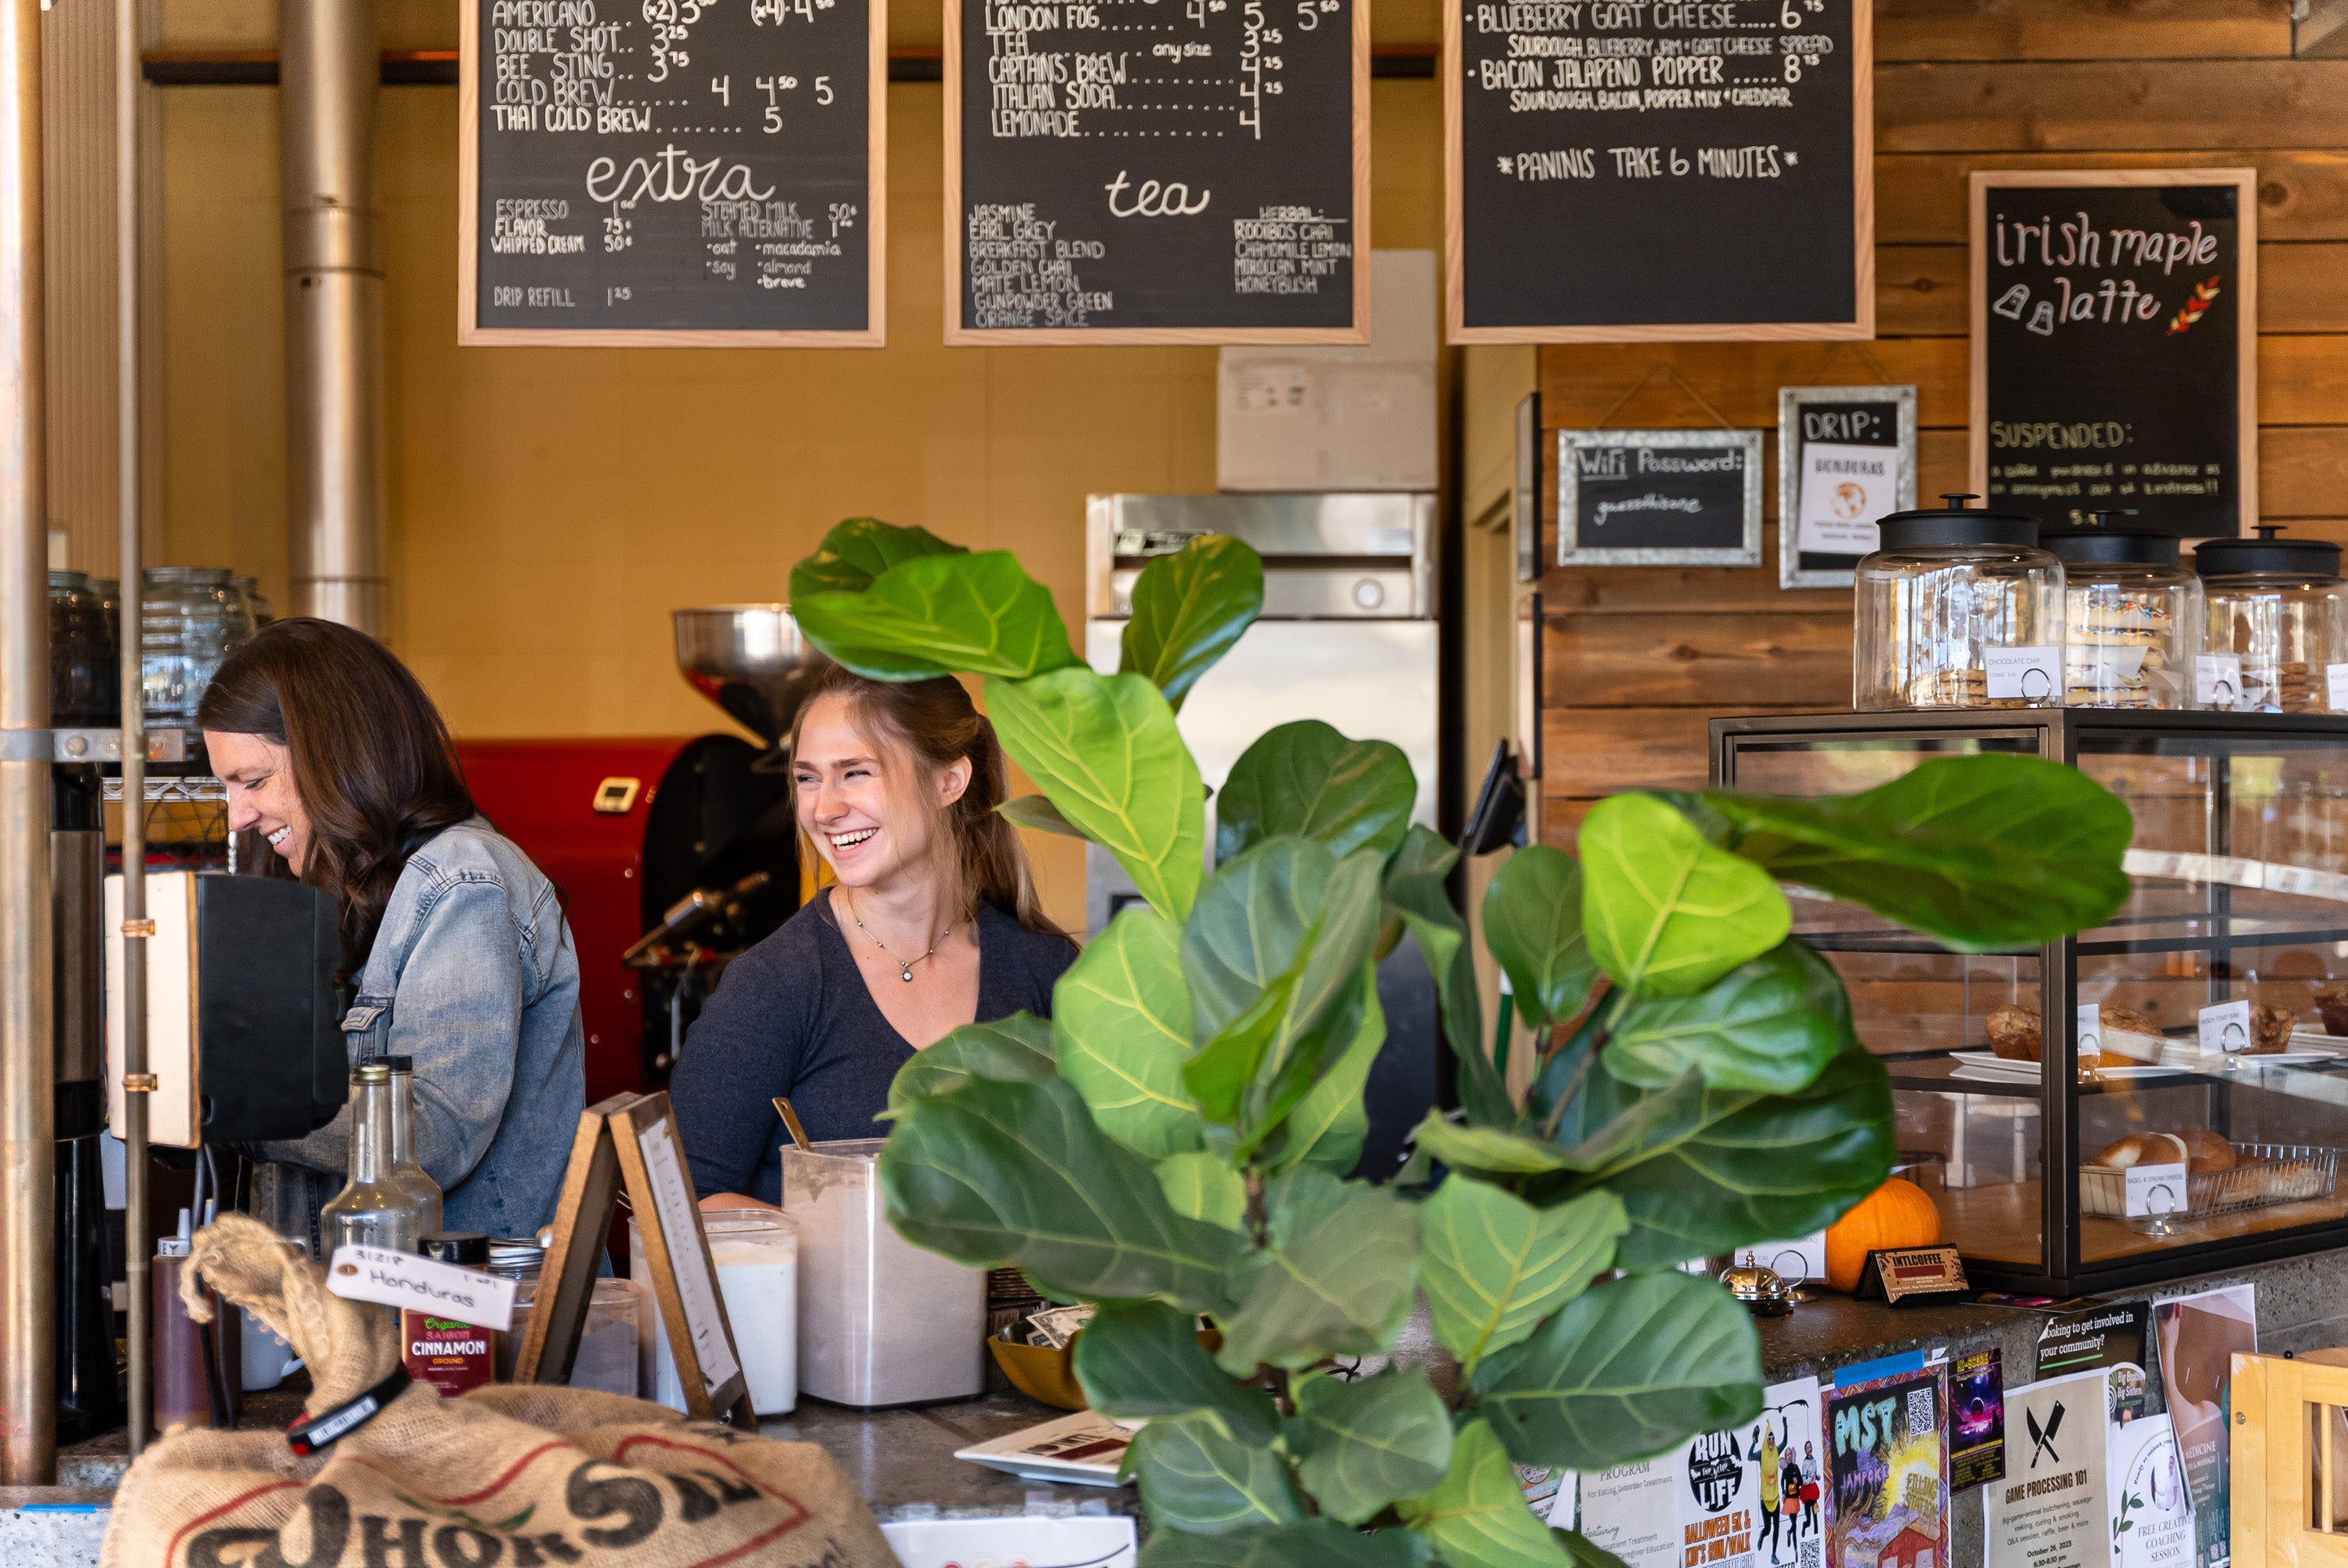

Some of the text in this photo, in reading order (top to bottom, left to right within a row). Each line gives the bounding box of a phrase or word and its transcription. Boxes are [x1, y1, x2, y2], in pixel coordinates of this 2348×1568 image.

[492, 0, 596, 27] AMERICANO
[985, 1, 1265, 31] LONDON FOG 5
[1477, 3, 1738, 34] BLUEBERRY GOAT CHEESE
[495, 28, 559, 53] DOUBLE
[985, 31, 1212, 64] TEA any size
[1692, 38, 1723, 55] GOAT
[1724, 37, 1773, 56] CHEESE
[1779, 34, 1834, 55] SPREAD
[496, 53, 532, 79] BEE
[1076, 54, 1127, 85] BREW
[1481, 55, 1724, 89] BACON JALAPENO POPPER
[496, 74, 834, 107] COLD BREW 4 5
[993, 80, 1116, 110] ITALIAN SODA
[1645, 87, 1793, 109] POPPER MIX CHEDDAR
[490, 104, 783, 134] THAI COLD BREW 5
[991, 109, 1261, 140] LEMONADE 4
[587, 143, 776, 202] extra
[1608, 144, 1781, 179] TAKE 6 MINUTES
[1104, 170, 1211, 217] tea
[496, 198, 569, 220] ESPRESSO
[701, 201, 801, 221] STEAMED MILK
[969, 202, 1036, 223] JASMINE
[495, 218, 548, 238] FLAVOR
[701, 219, 814, 239] MILK ALTERNATIVE
[969, 220, 1057, 241] EARL GREY
[1234, 221, 1333, 241] ROOIBOS CHAI
[491, 235, 586, 255] WHIPPED CREAM
[712, 238, 842, 256] oat macadamia
[969, 240, 1106, 259] BREAKFAST BLEND
[1235, 240, 1351, 259] CHAMOMILE LEMON
[1996, 212, 2218, 276] irish maple
[712, 258, 812, 281] soy almond
[971, 258, 1072, 275] GOLDEN CHAI
[1301, 259, 1338, 274] MINT
[763, 274, 806, 289] breve
[972, 274, 1080, 293] MATE LEMON
[1235, 275, 1318, 294] HONEYBUSH
[494, 285, 576, 307] DRIP REFILL
[974, 291, 1113, 311] GUNPOWDER GREEN
[2053, 277, 2161, 324] latte
[976, 309, 1089, 328] ORANGE SPICE
[1804, 411, 1881, 440] DRIP:
[1990, 420, 2134, 449] SUSPENDED:
[369, 1269, 474, 1308] Honduras
[2072, 1312, 2133, 1334] to get involved in
[426, 1331, 470, 1341] SAIGON
[412, 1341, 487, 1356] CINNAMON
[2041, 1334, 2105, 1361] your community?
[1835, 1396, 1896, 1457] MST
[1696, 1431, 1732, 1461] RUN
[1600, 1461, 1650, 1482] PROGRAM
[1598, 1487, 1617, 1497] Eating
[1618, 1482, 1642, 1493] Disorder
[1644, 1476, 1673, 1487] Treatment
[1699, 1477, 1736, 1510] LIFE
[2005, 1468, 2087, 1504] GAME PROCESSING 101
[1584, 1524, 1619, 1541] Featuring
[1685, 1509, 1750, 1545] HALLOWEEN 5K &
[2035, 1518, 2051, 1527] curing
[2138, 1515, 2193, 1537] FREE CREATIVE
[1628, 1534, 1657, 1545] Treatment
[1646, 1542, 1674, 1553] Education
[1685, 1543, 1706, 1568] KID'S
[1708, 1531, 1750, 1562] RUN/WALK
[2007, 1537, 2019, 1546] Q&A
[2027, 1547, 2048, 1558] October
[2059, 1541, 2072, 1550] 2023
[2146, 1530, 2186, 1549] COACHING
[2150, 1545, 2180, 1563] SESSION
